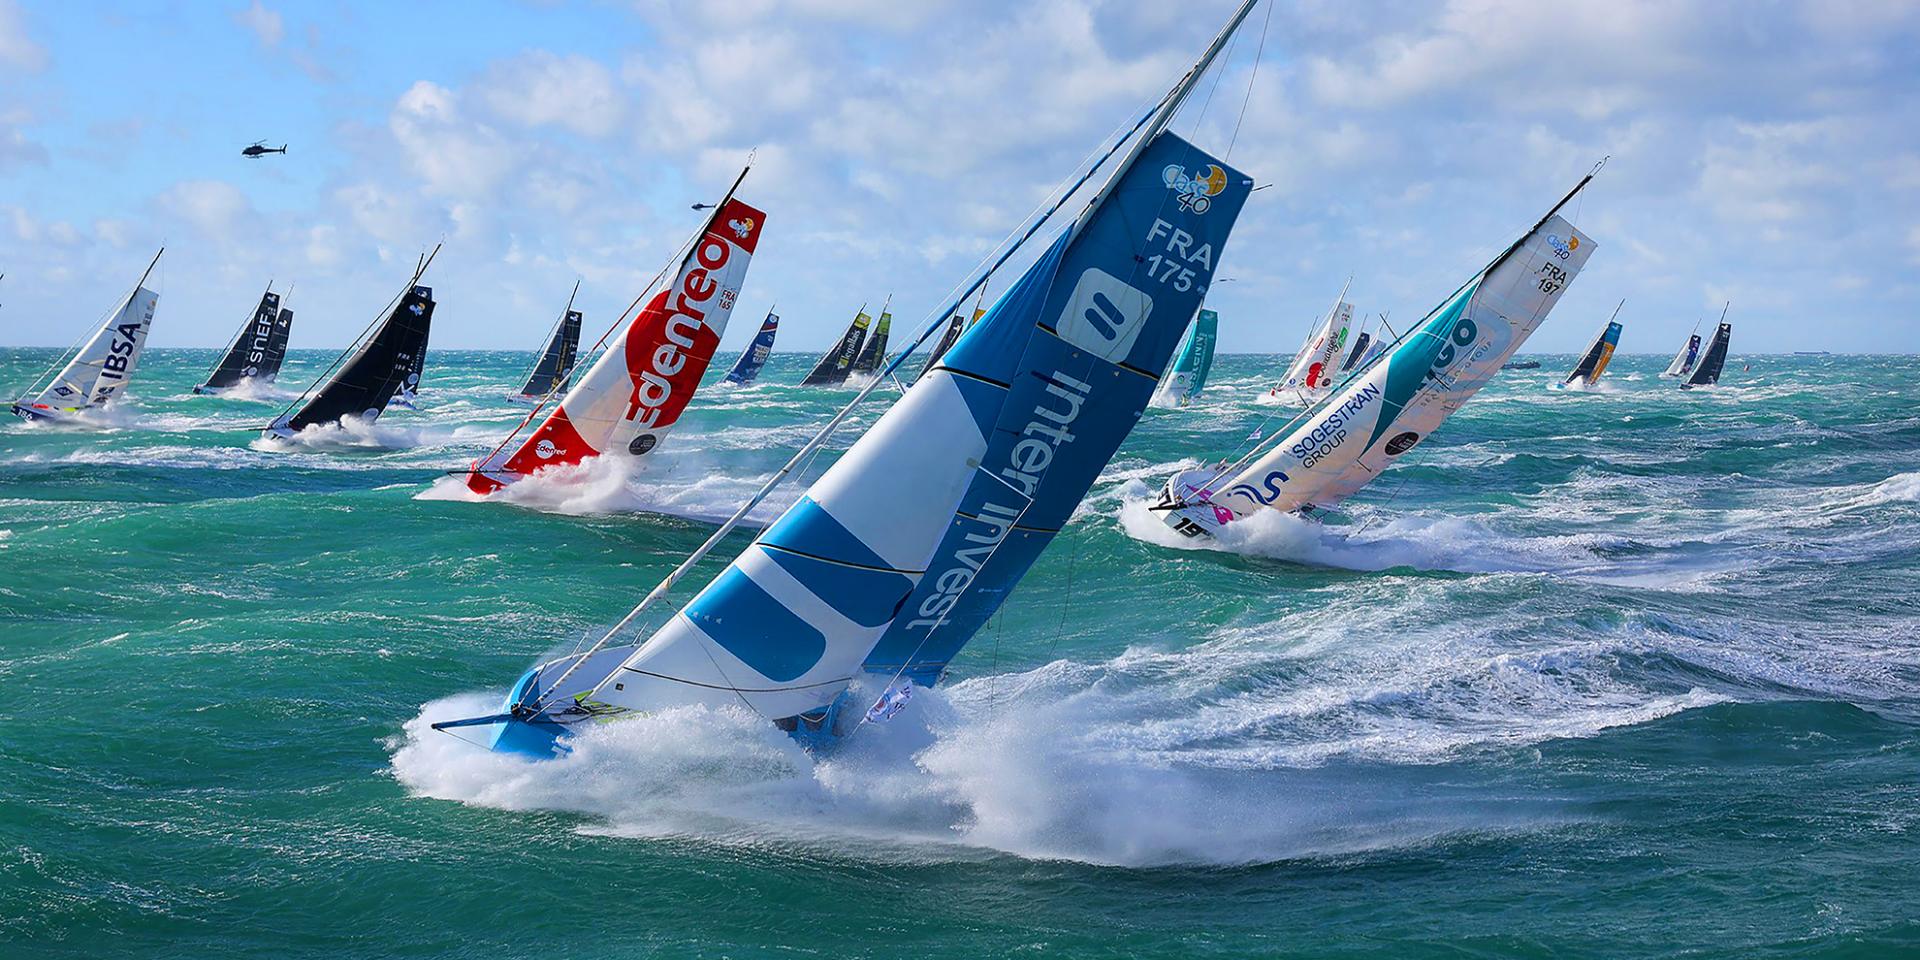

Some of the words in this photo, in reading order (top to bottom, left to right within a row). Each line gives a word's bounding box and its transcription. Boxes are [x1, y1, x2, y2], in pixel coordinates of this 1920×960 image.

[1162, 164, 1210, 198] Class
[1177, 192, 1211, 214] 40
[1146, 217, 1212, 272] FRA
[1554, 248, 1570, 260] 40
[1147, 254, 1196, 293] 175
[1538, 278, 1560, 296] 197
[1541, 261, 1567, 285] FRA
[718, 299, 732, 310] 165
[721, 289, 736, 302] FRA
[623, 235, 731, 426] Edenred
[101, 323, 142, 380] IBSA
[17, 408, 33, 421] 186
[1292, 382, 1380, 459] SOGESTRAN
[1001, 370, 1092, 497] Inter
[1302, 429, 1347, 469] GROUP
[904, 502, 1020, 631] Invest
